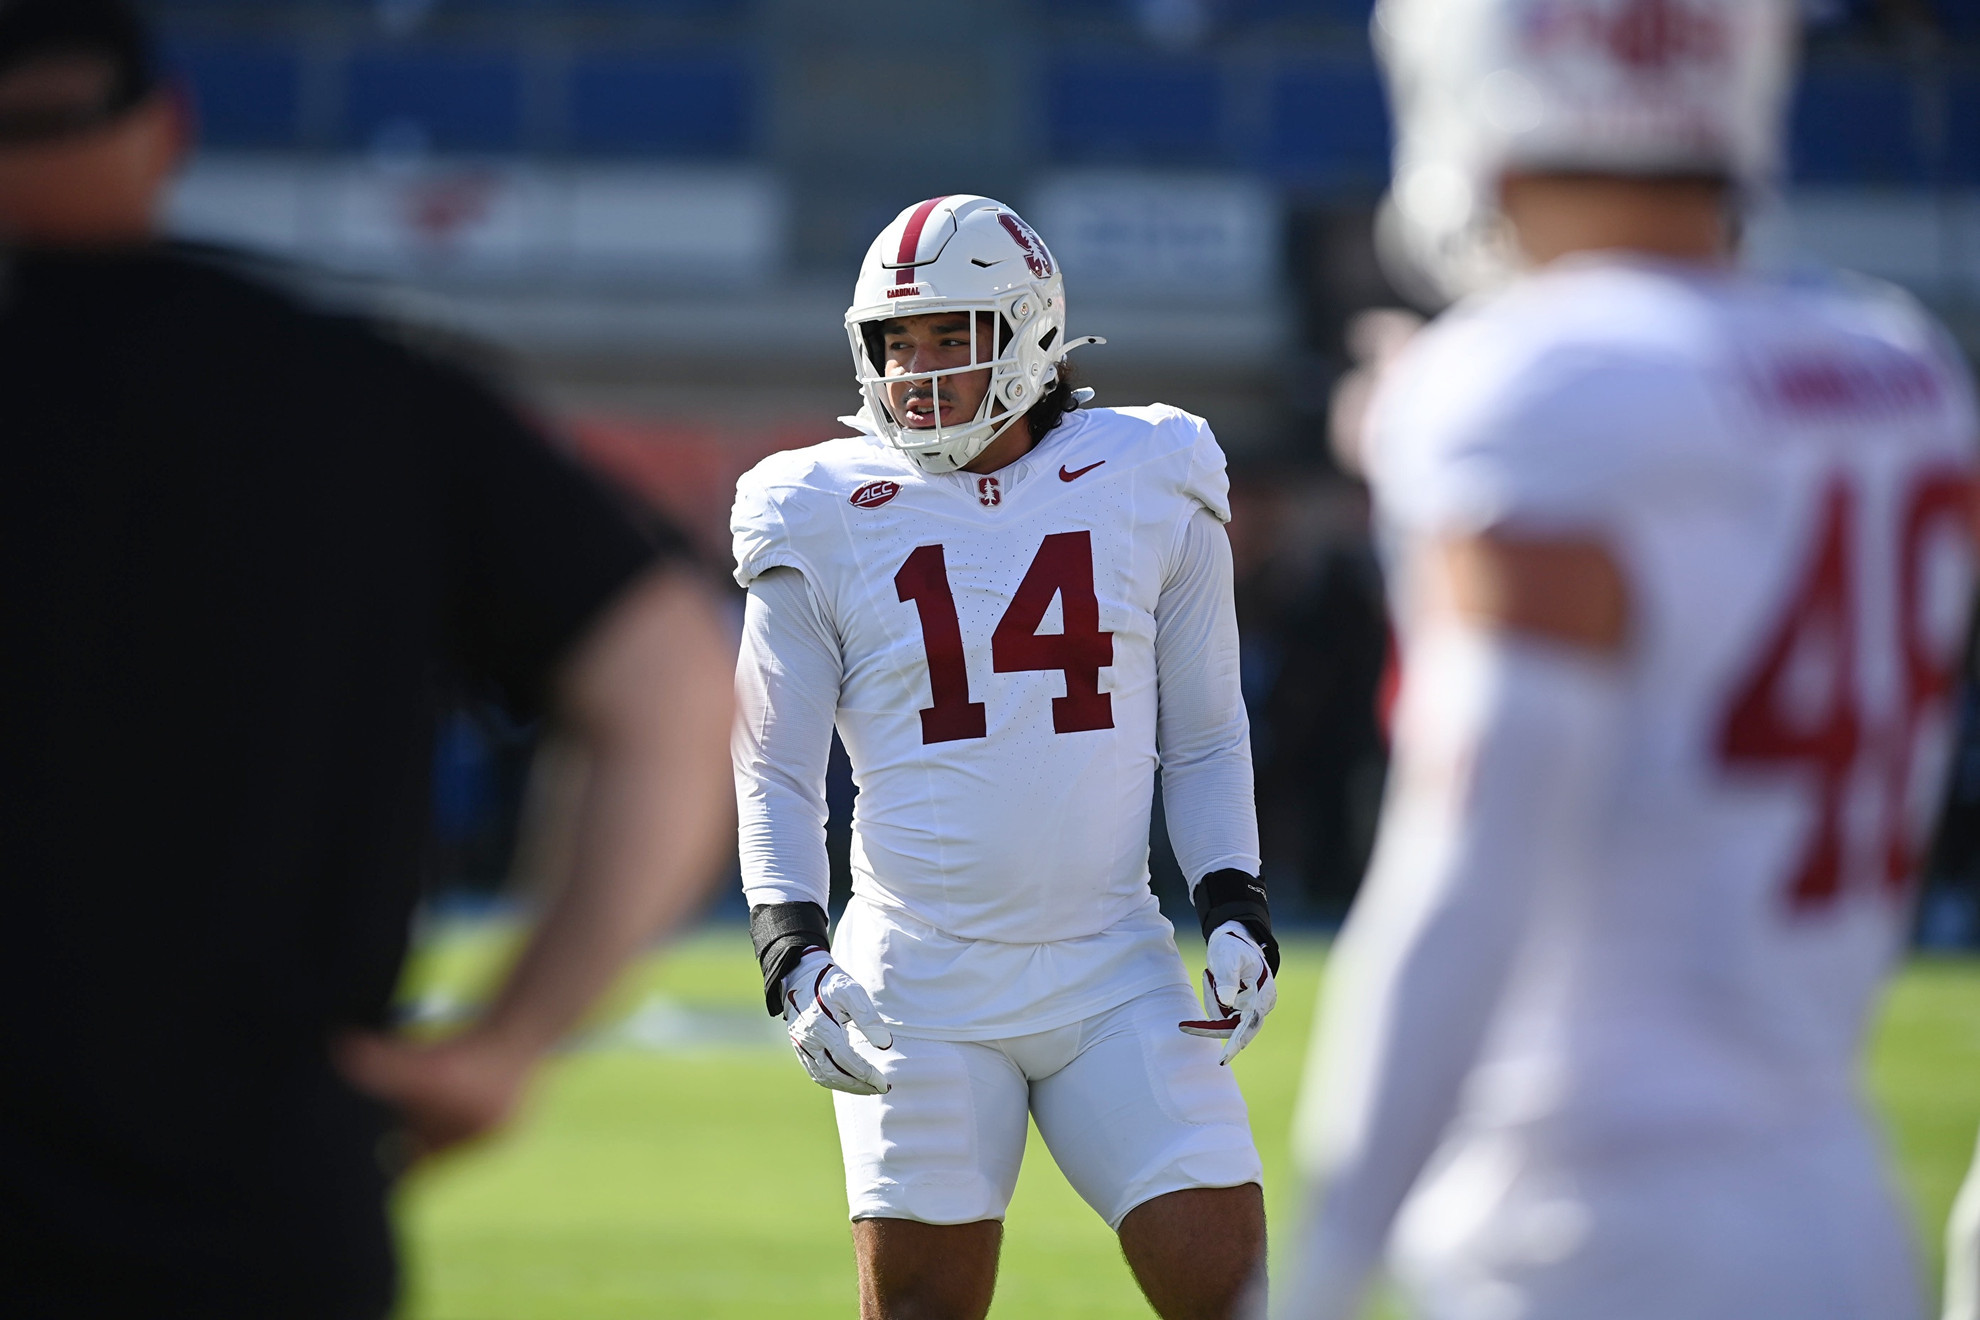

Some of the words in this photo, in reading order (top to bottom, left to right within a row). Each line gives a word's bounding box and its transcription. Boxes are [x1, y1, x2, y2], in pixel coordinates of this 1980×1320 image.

[887, 286, 920, 299] CARDINAL
[857, 481, 893, 502] ACC
[894, 530, 1115, 745] 14
